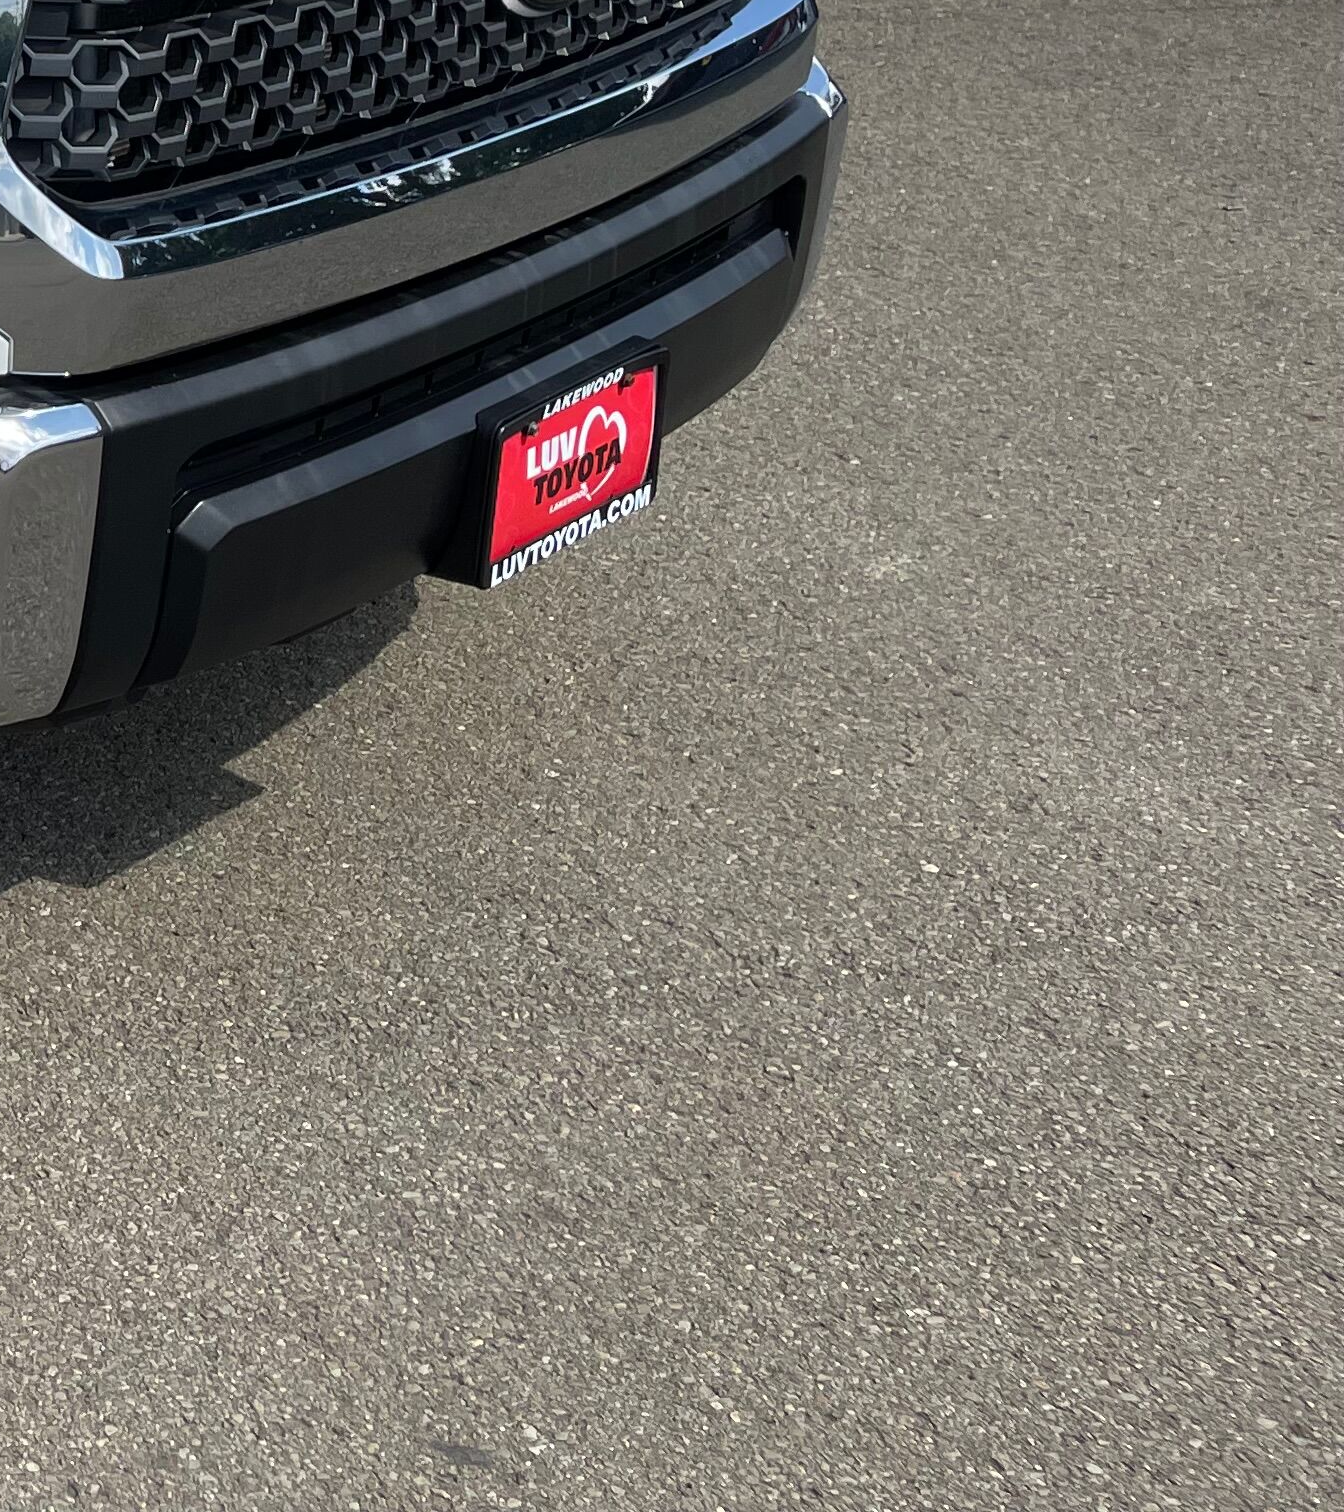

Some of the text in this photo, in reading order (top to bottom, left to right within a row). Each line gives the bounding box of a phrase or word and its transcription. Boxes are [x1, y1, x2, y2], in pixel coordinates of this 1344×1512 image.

[542, 367, 625, 420] LAKEWOOD
[526, 426, 578, 480] LUV
[533, 437, 622, 506] TOYOTA
[490, 484, 652, 588] LUVTOYOTA.COM
